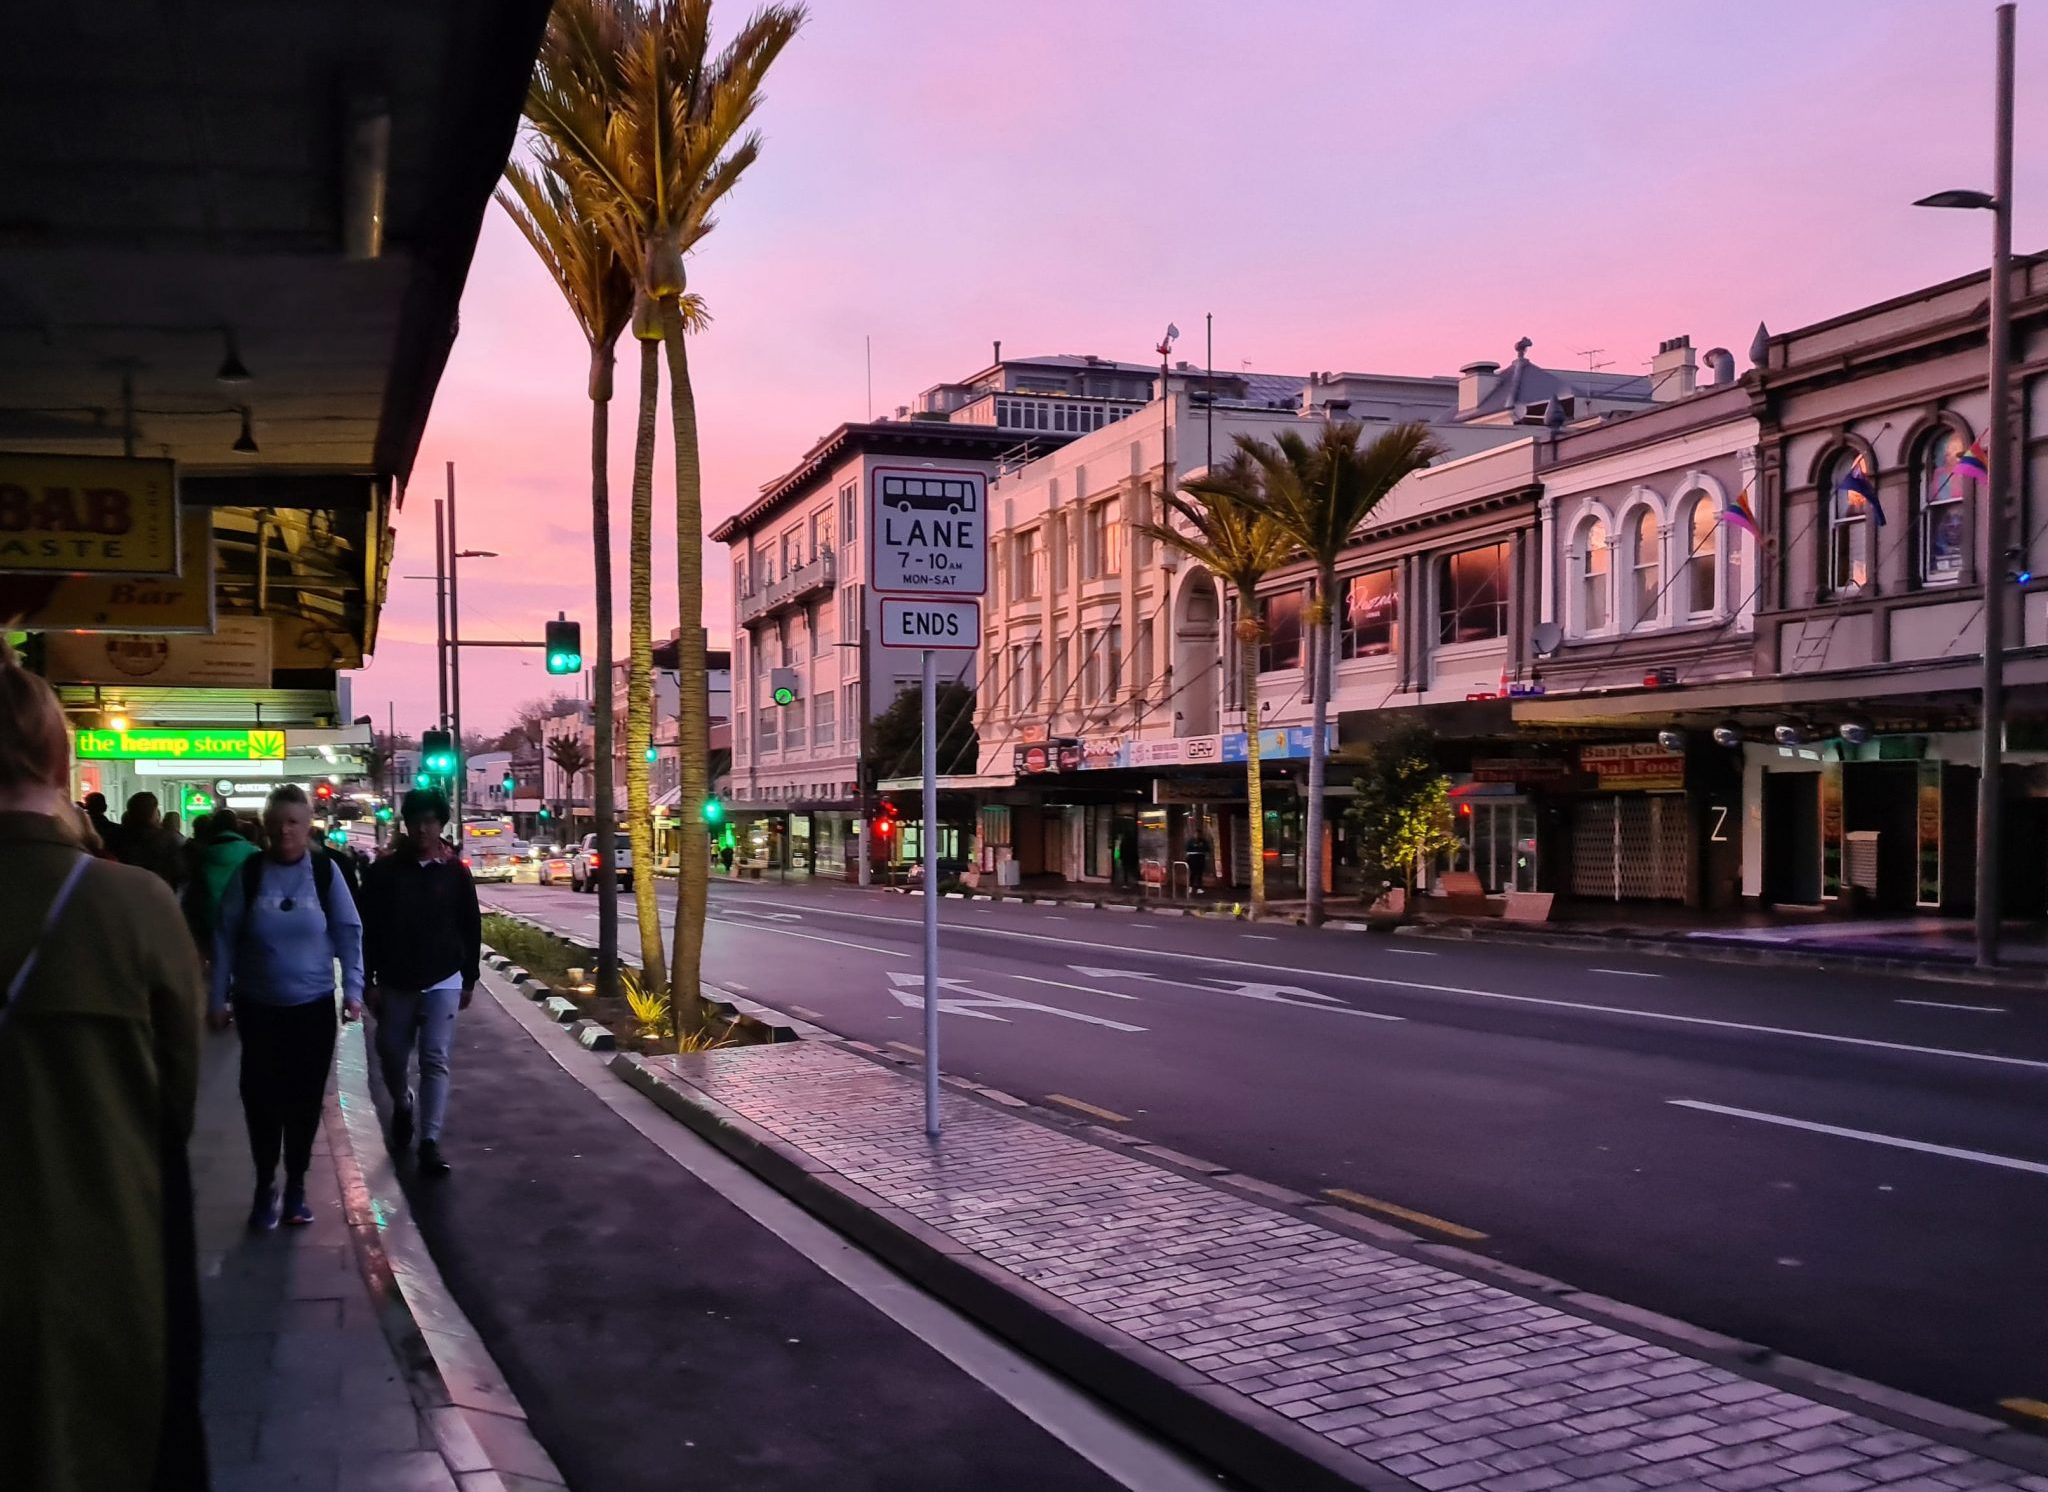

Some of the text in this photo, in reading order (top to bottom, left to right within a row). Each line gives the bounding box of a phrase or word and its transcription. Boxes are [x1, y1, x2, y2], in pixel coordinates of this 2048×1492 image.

[886, 518, 974, 548] LANE
[903, 575, 957, 585] MON-SAT
[109, 584, 183, 605] Bar
[903, 612, 959, 635] ENDS
[80, 733, 247, 756] the hemp store
[1634, 759, 1683, 773] Food
